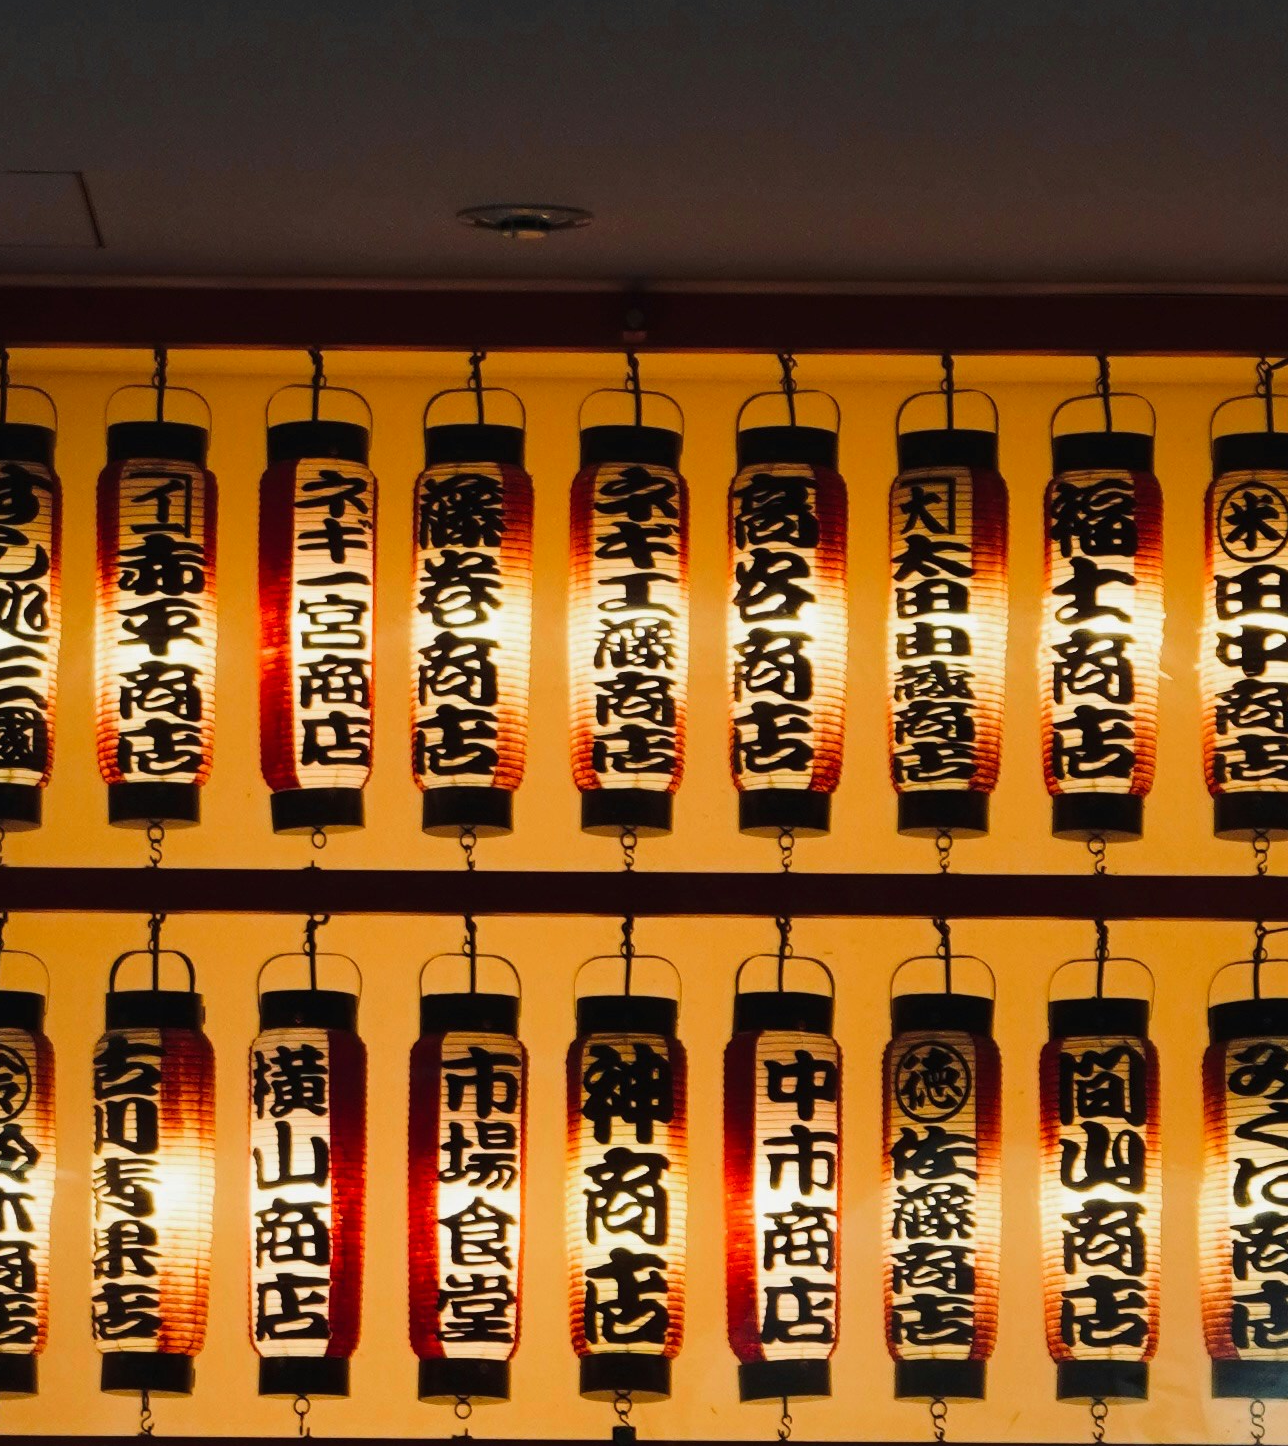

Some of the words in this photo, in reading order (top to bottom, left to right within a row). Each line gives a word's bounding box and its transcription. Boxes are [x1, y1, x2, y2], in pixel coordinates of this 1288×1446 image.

[252, 1044, 332, 1341] 横山商店
[438, 1046, 520, 1343] 市場食堂
[581, 1044, 673, 1345] 神商店
[761, 1050, 837, 1344] 中市商店
